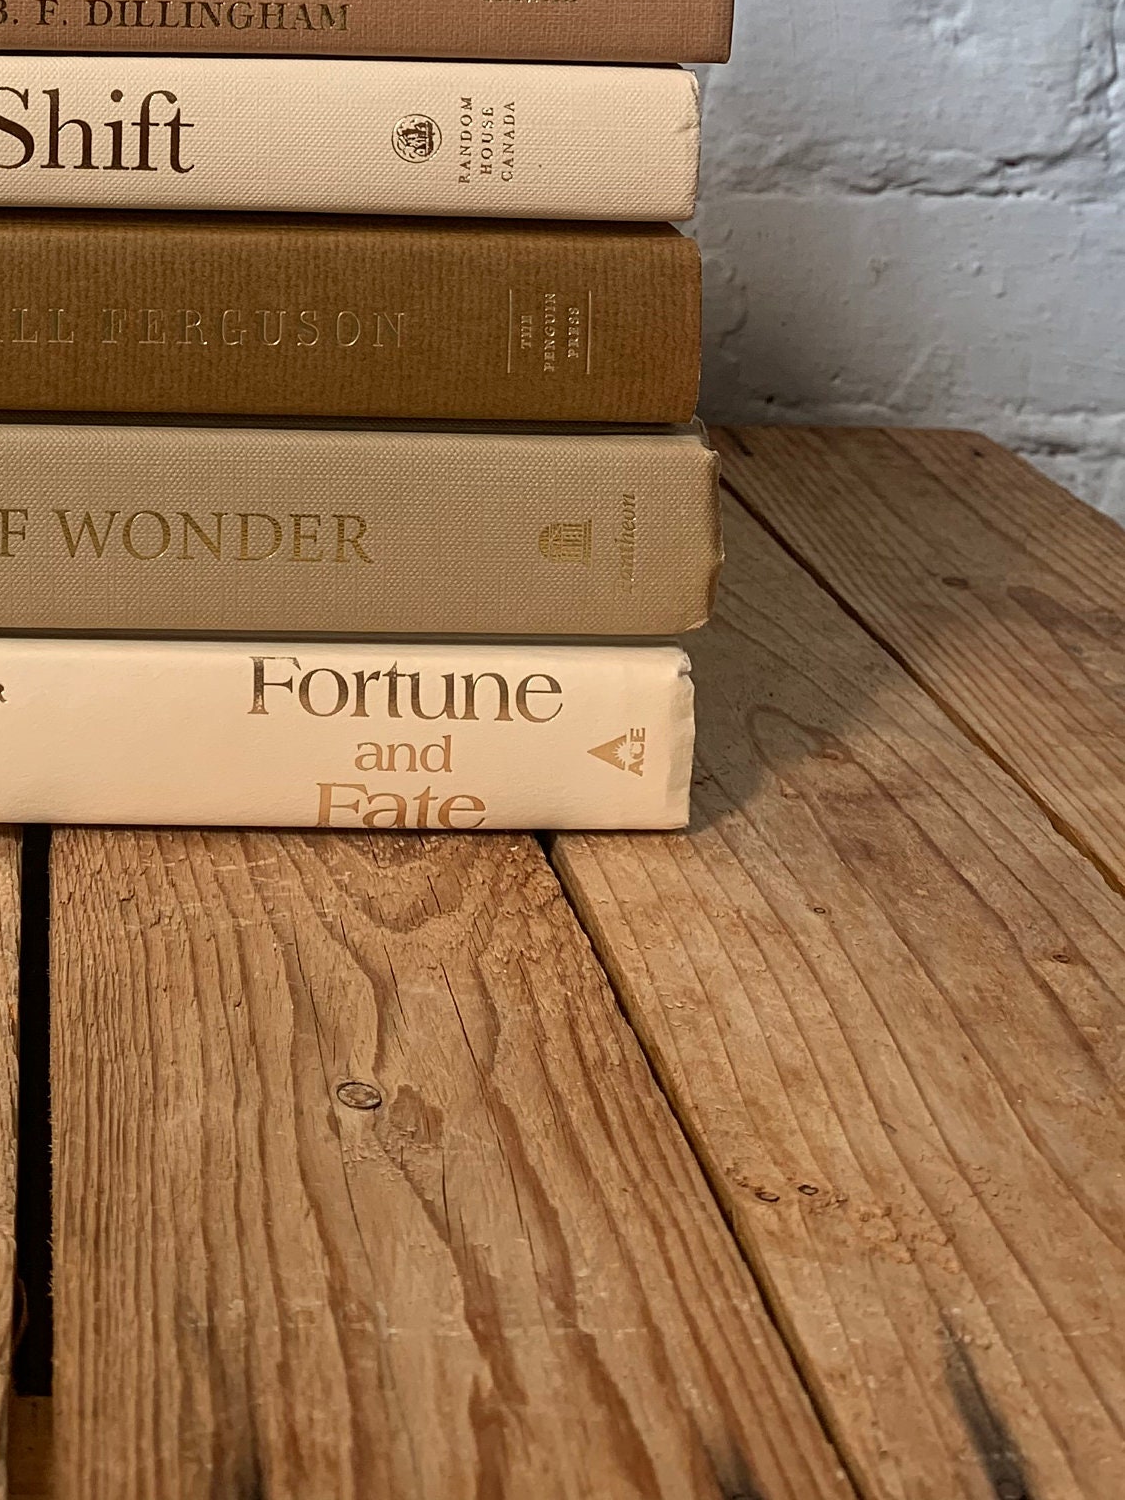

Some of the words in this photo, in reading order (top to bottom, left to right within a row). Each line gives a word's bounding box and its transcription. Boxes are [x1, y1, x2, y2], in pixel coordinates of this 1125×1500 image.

[458, 96, 473, 184] RANDOM
[480, 107, 494, 175] HOUSE
[501, 101, 515, 182] CANADA
[101, 307, 406, 349] FERGUSON
[520, 314, 532, 350] THE
[543, 293, 556, 372] PENGUIN
[567, 307, 580, 358] PRESS
[51, 508, 374, 564] WONDER
[247, 655, 564, 724] Fortune
[354, 734, 453, 773] and
[628, 727, 646, 777] ACE
[316, 782, 487, 829] Fate
